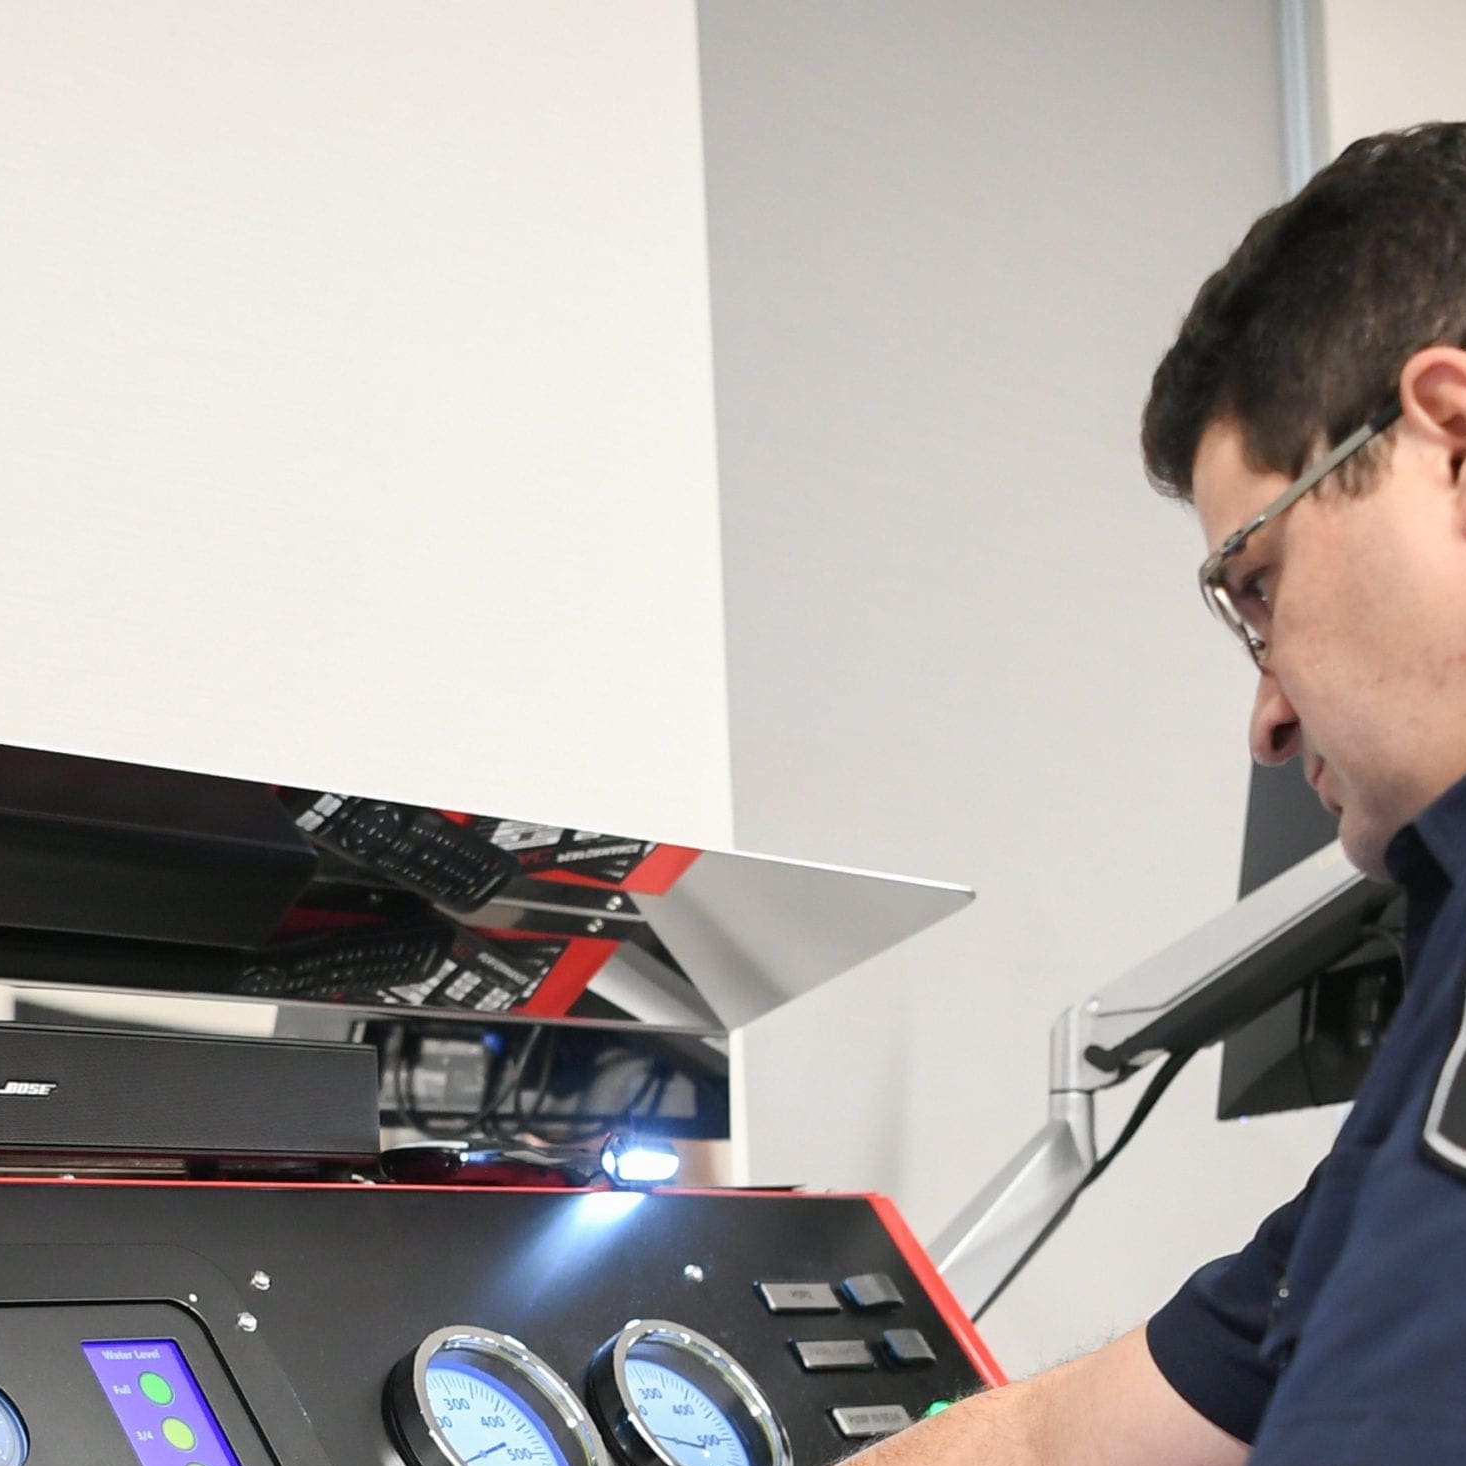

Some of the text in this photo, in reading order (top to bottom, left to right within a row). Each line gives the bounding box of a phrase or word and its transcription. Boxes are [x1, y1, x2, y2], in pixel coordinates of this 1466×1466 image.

[102, 1349, 161, 1360] Water Level
[113, 1384, 132, 1394] Full
[638, 1388, 662, 1400] 300
[443, 1398, 470, 1410] 300
[672, 1404, 695, 1416] 400
[435, 1416, 453, 1428] 00
[481, 1416, 506, 1427] 400
[135, 1431, 154, 1441] 3/4
[697, 1434, 721, 1447] 500
[507, 1448, 533, 1461] 500
